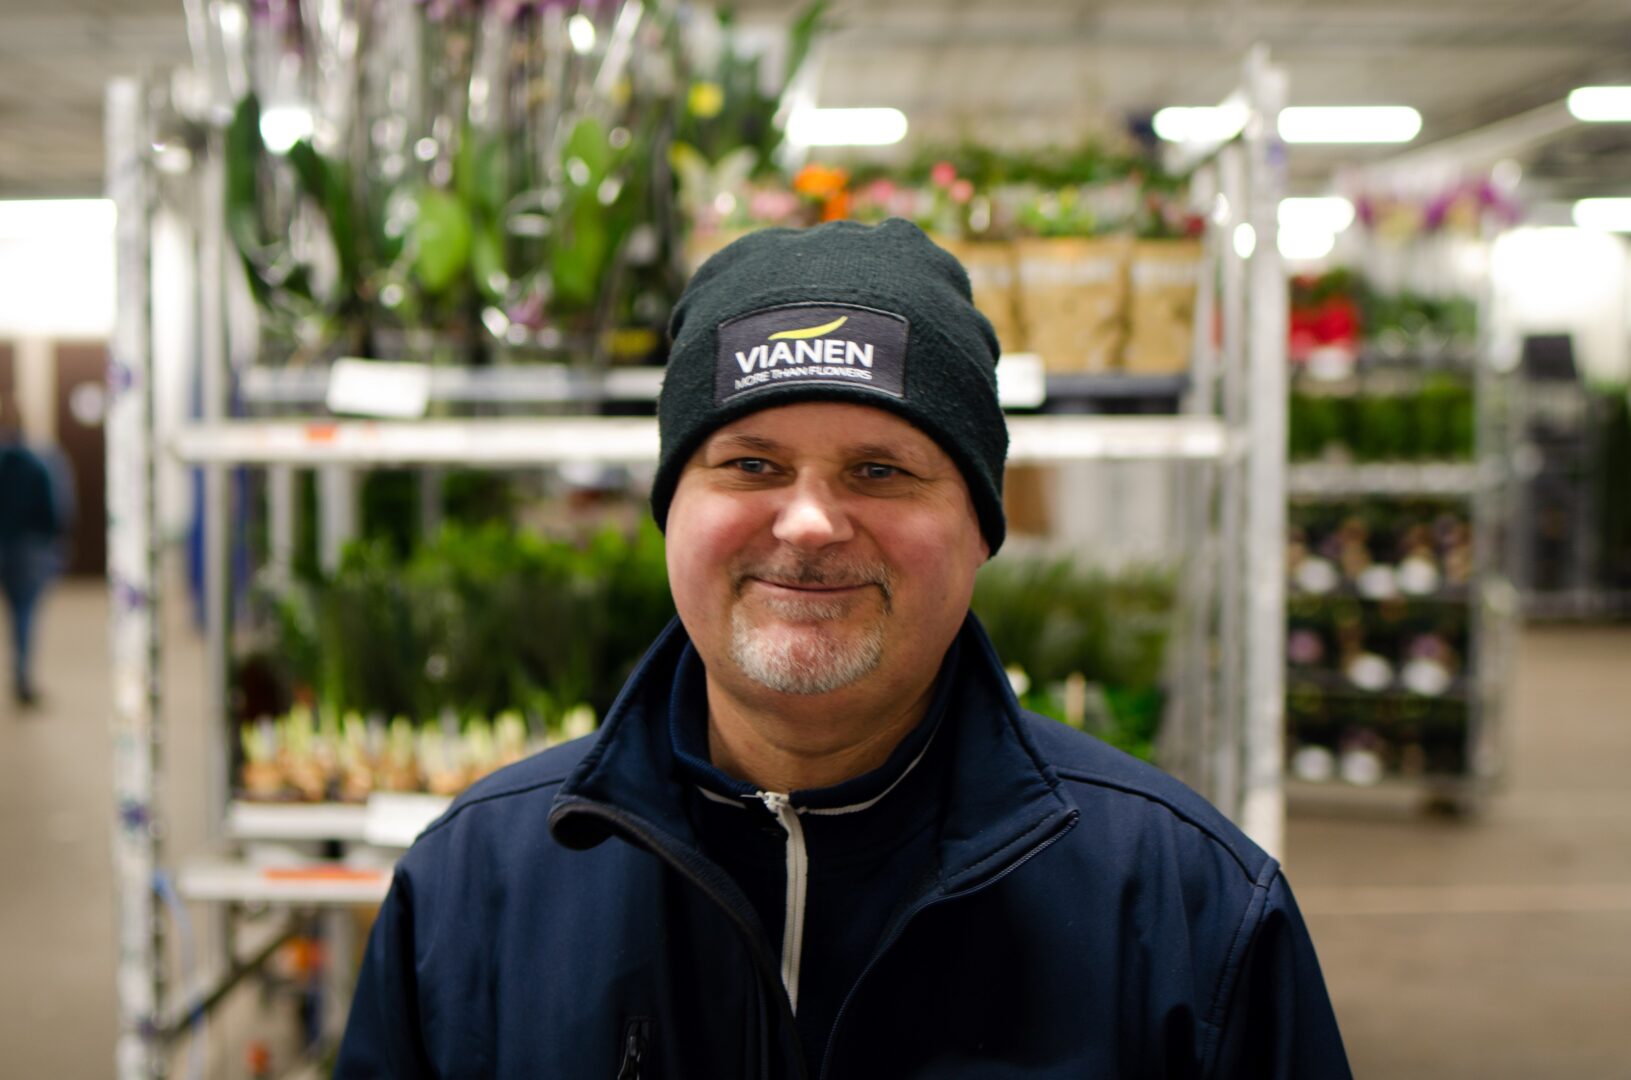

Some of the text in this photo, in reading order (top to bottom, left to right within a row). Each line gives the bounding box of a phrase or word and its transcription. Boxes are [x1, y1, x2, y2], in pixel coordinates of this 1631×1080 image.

[735, 339, 874, 373] VIANEN
[735, 366, 873, 390] MORE THAN FLOWERS
